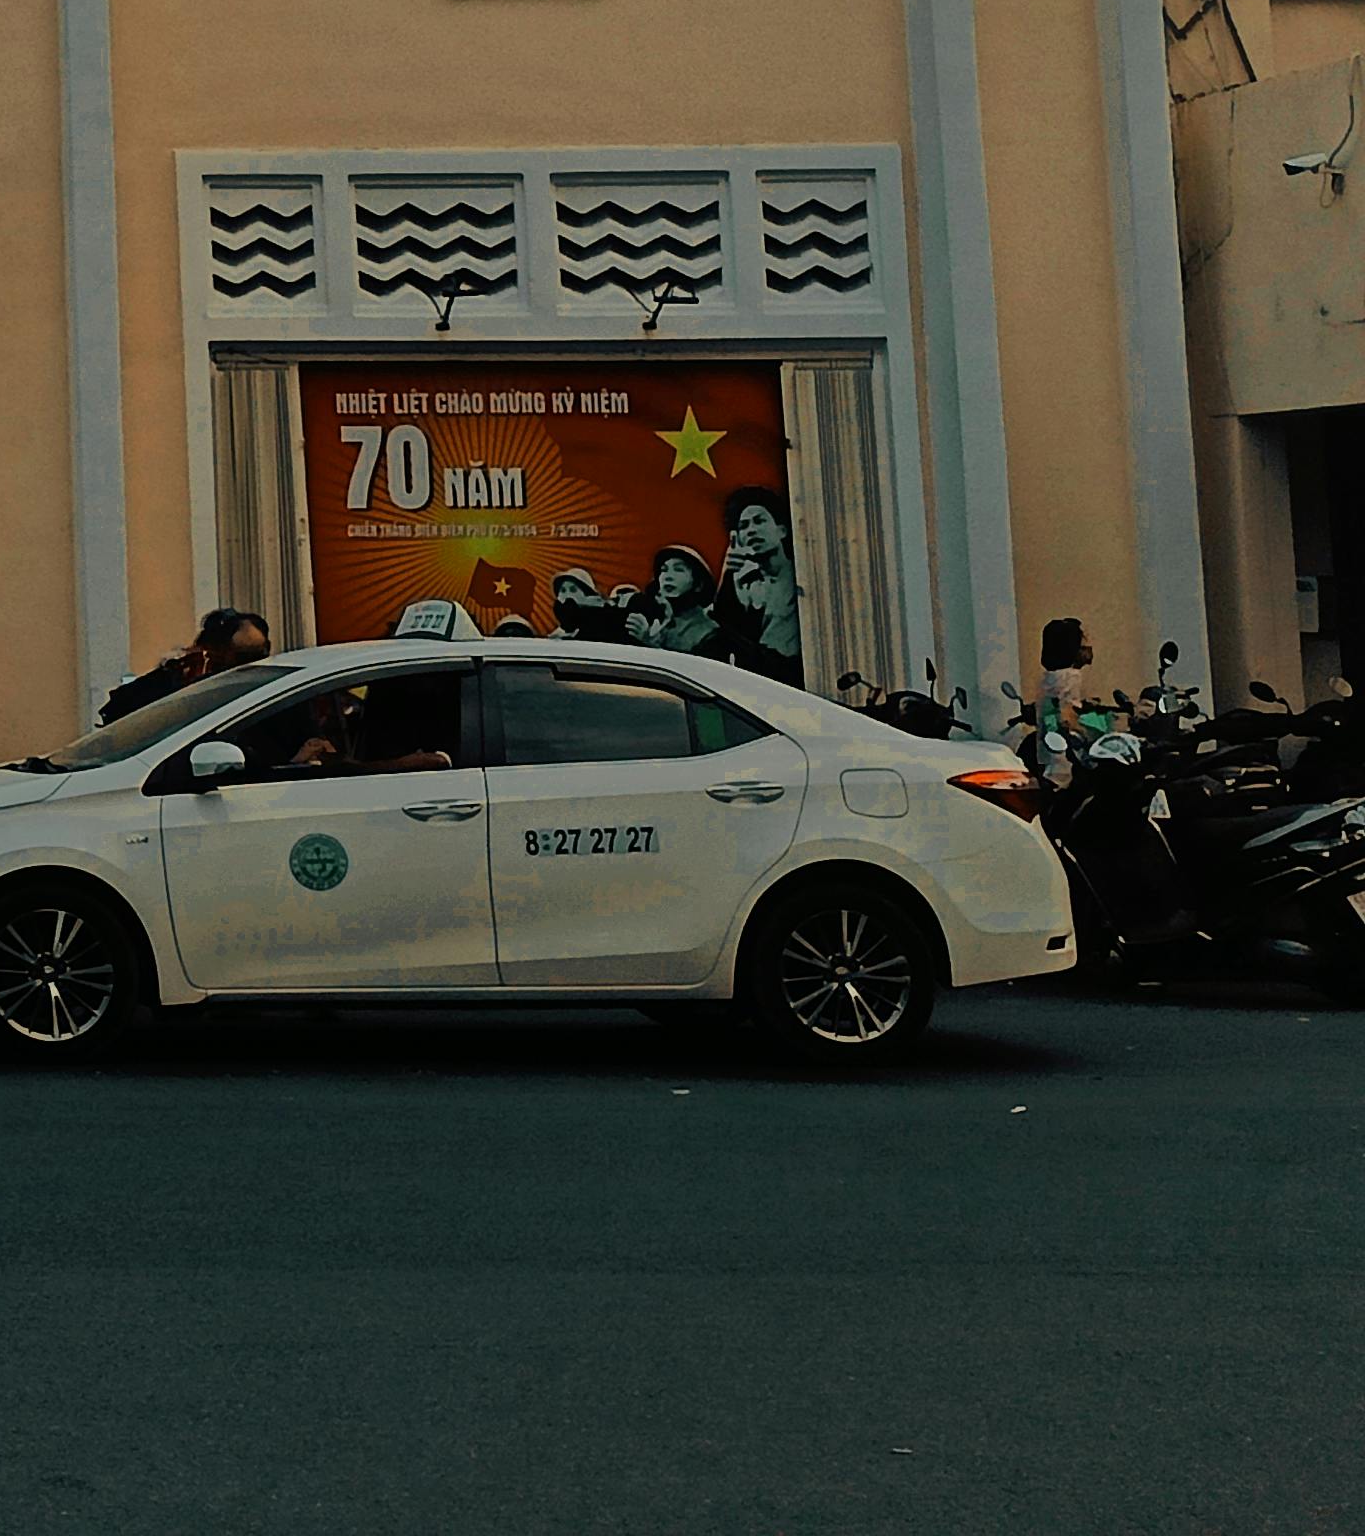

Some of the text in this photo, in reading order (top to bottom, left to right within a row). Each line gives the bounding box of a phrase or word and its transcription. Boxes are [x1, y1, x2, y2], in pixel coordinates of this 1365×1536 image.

[335, 389, 388, 420] NHIỆT
[392, 389, 430, 420] LIỆT
[434, 389, 485, 415] CHÀO
[489, 389, 547, 414] MỪNG
[580, 388, 630, 419] NIỆM
[340, 424, 525, 510] 70 NĂM
[589, 827, 618, 855] 27
[625, 826, 655, 854] 27
